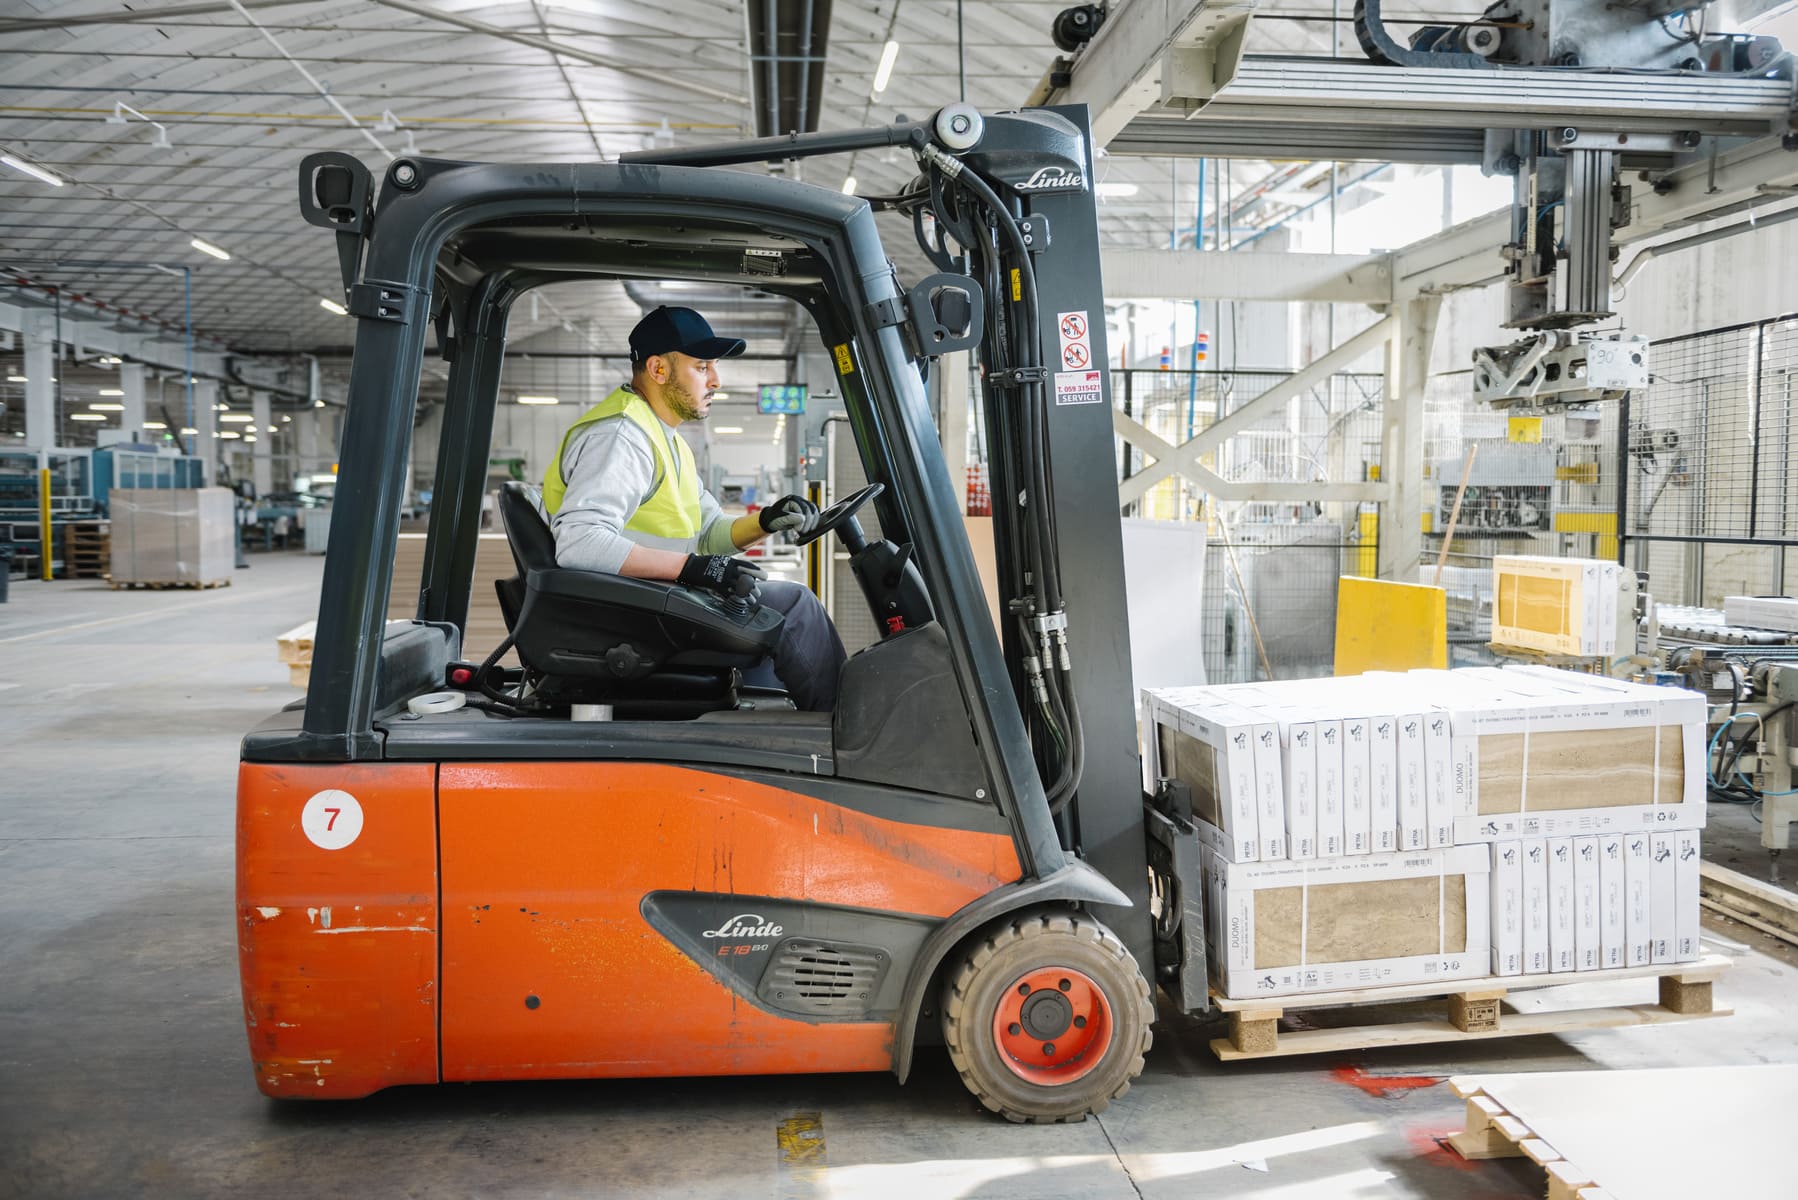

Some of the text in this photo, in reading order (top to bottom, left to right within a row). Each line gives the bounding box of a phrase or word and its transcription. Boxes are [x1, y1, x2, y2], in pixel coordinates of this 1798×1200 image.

[1014, 166, 1082, 190] Linde
[1062, 393, 1097, 402] SERVICE
[1455, 762, 1464, 794] DUOMO
[324, 807, 341, 831] 7
[702, 913, 783, 938] Linde
[1231, 916, 1240, 949] DUOMO
[718, 946, 731, 956] E
